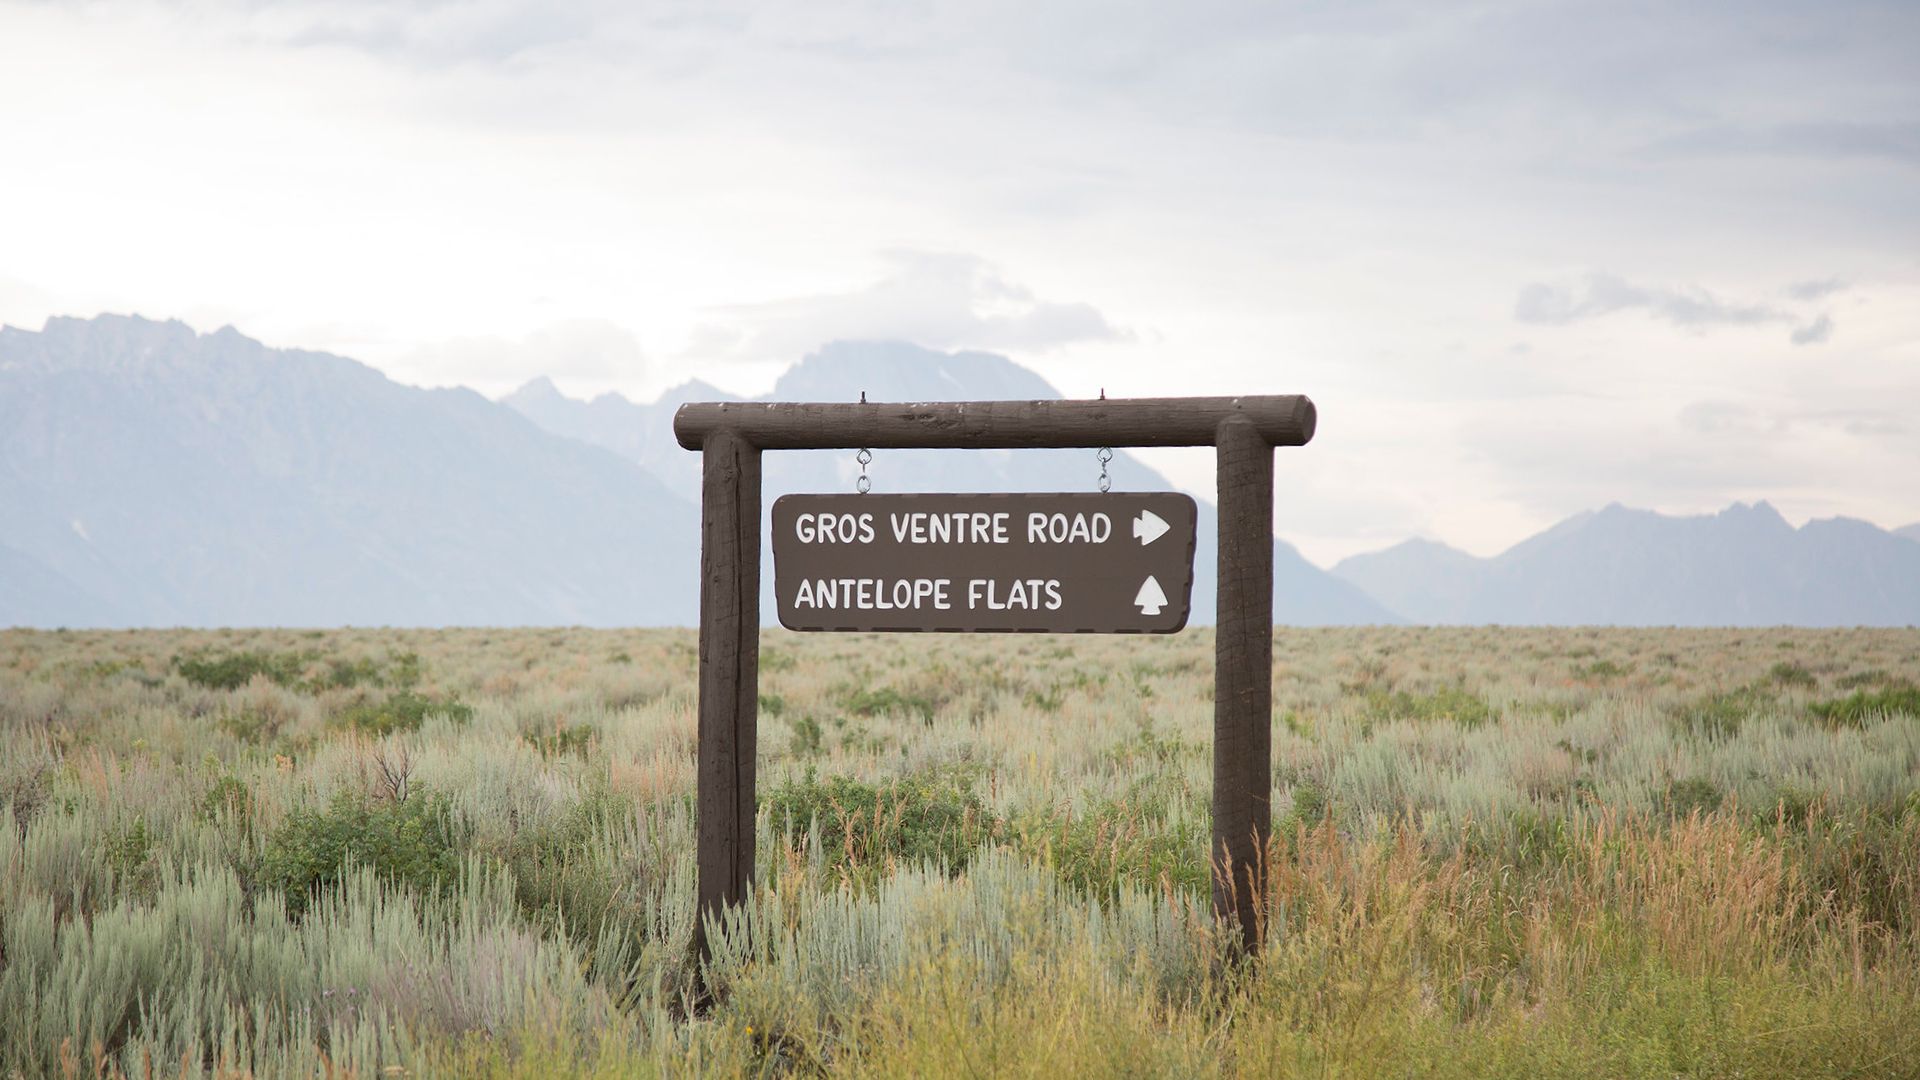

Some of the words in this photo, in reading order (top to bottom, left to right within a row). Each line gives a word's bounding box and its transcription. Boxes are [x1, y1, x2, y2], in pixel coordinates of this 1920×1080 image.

[795, 513, 875, 544] GROS
[890, 512, 1010, 544] VENTRE
[1027, 513, 1112, 544] ROAD
[794, 578, 951, 610] ANTELOPE
[968, 579, 1063, 610] FLATS
